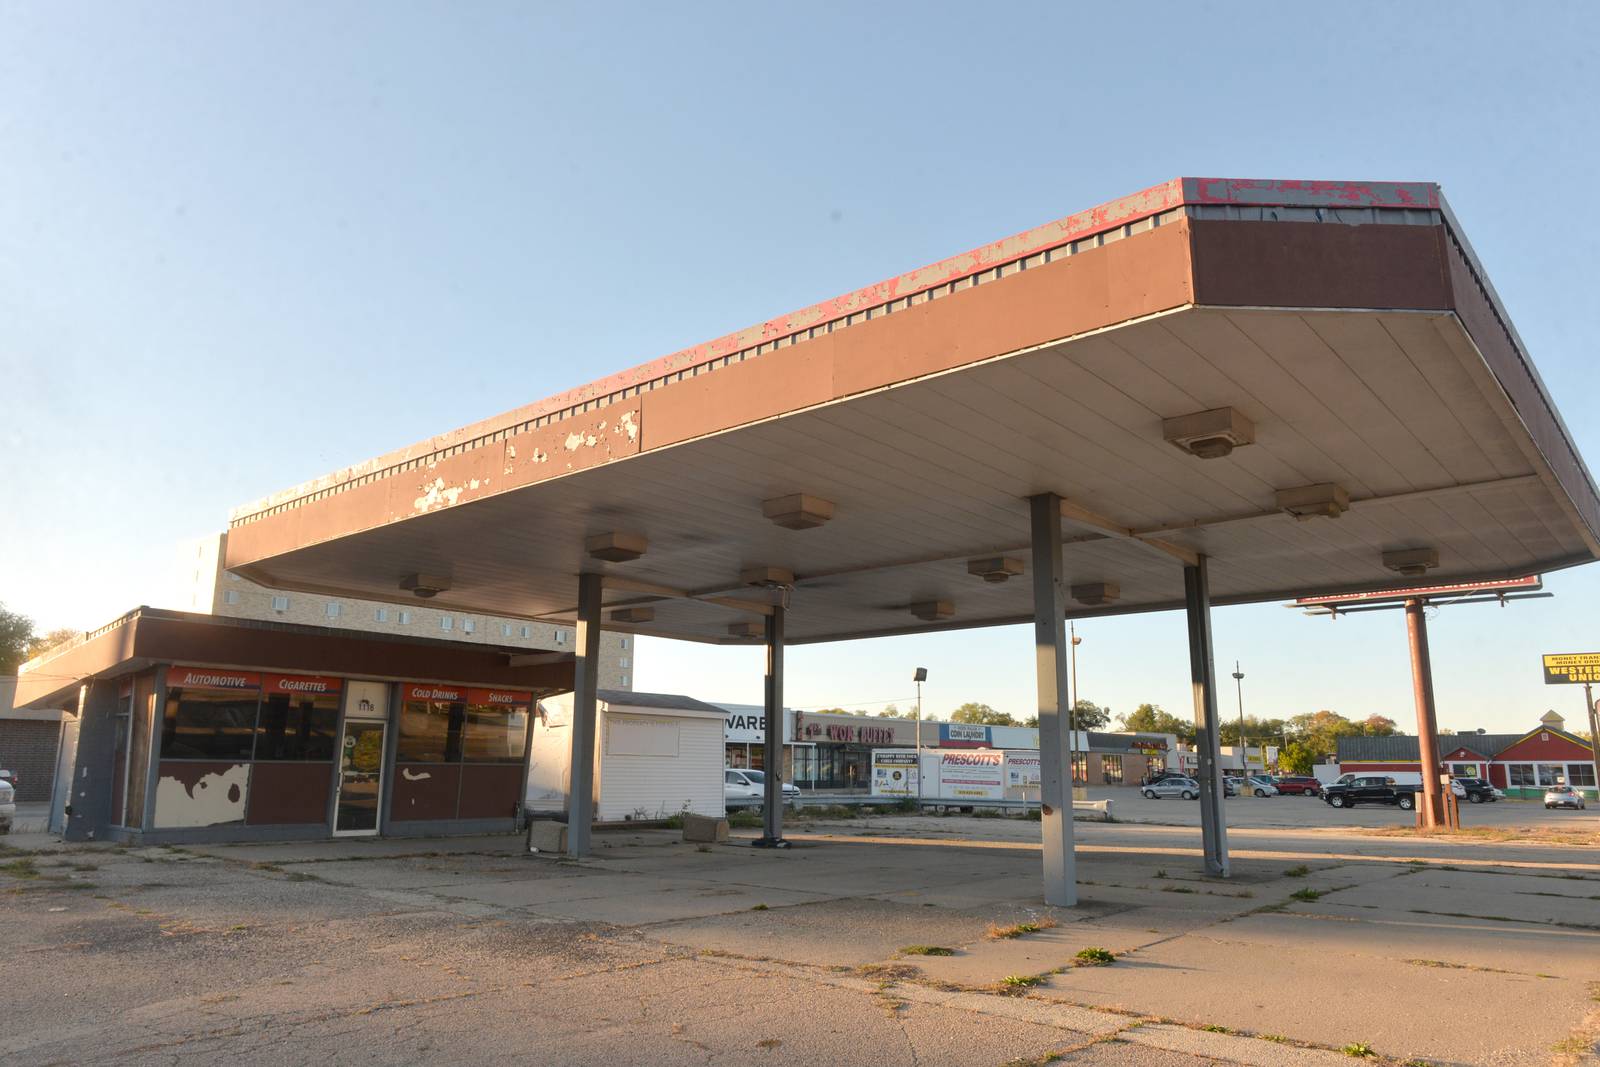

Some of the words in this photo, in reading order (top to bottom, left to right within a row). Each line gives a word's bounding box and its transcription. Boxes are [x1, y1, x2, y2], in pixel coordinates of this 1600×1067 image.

[184, 672, 247, 687] AUTOMOTIVE
[279, 679, 327, 692] CIGARETTES
[412, 688, 431, 698] COLD
[432, 689, 459, 700] DRINKS
[488, 693, 513, 703] SNACKS
[942, 753, 1001, 766] PRESCOTT'S
